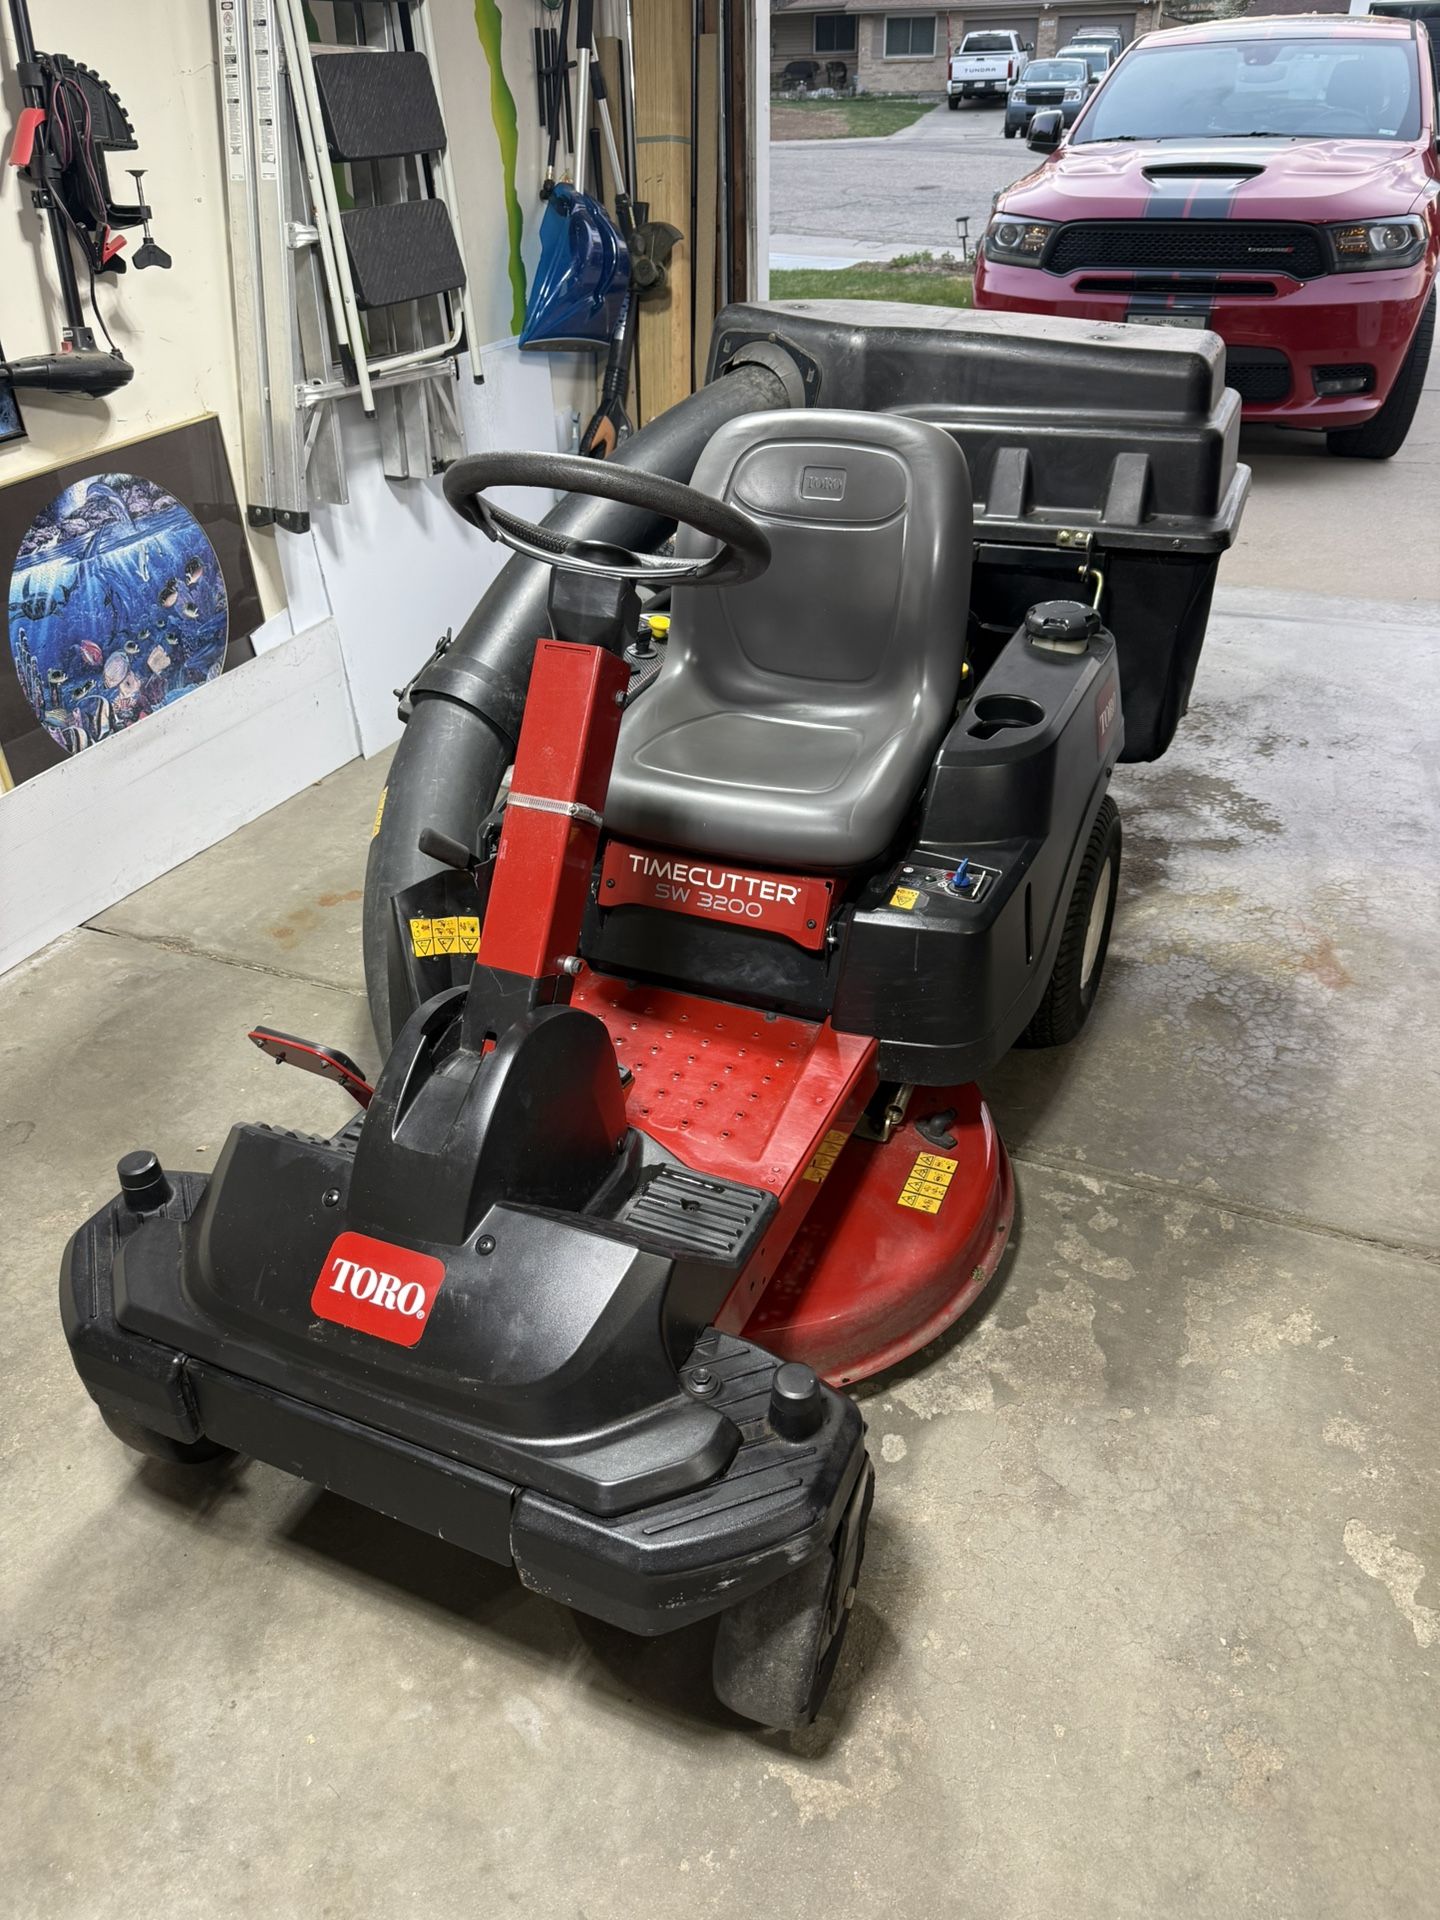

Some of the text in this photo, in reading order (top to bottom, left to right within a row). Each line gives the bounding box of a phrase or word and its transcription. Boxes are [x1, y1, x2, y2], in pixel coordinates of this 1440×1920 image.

[804, 475, 843, 491] TORO
[629, 853, 799, 906] TIMECUTTER
[655, 883, 763, 918] SW 3200
